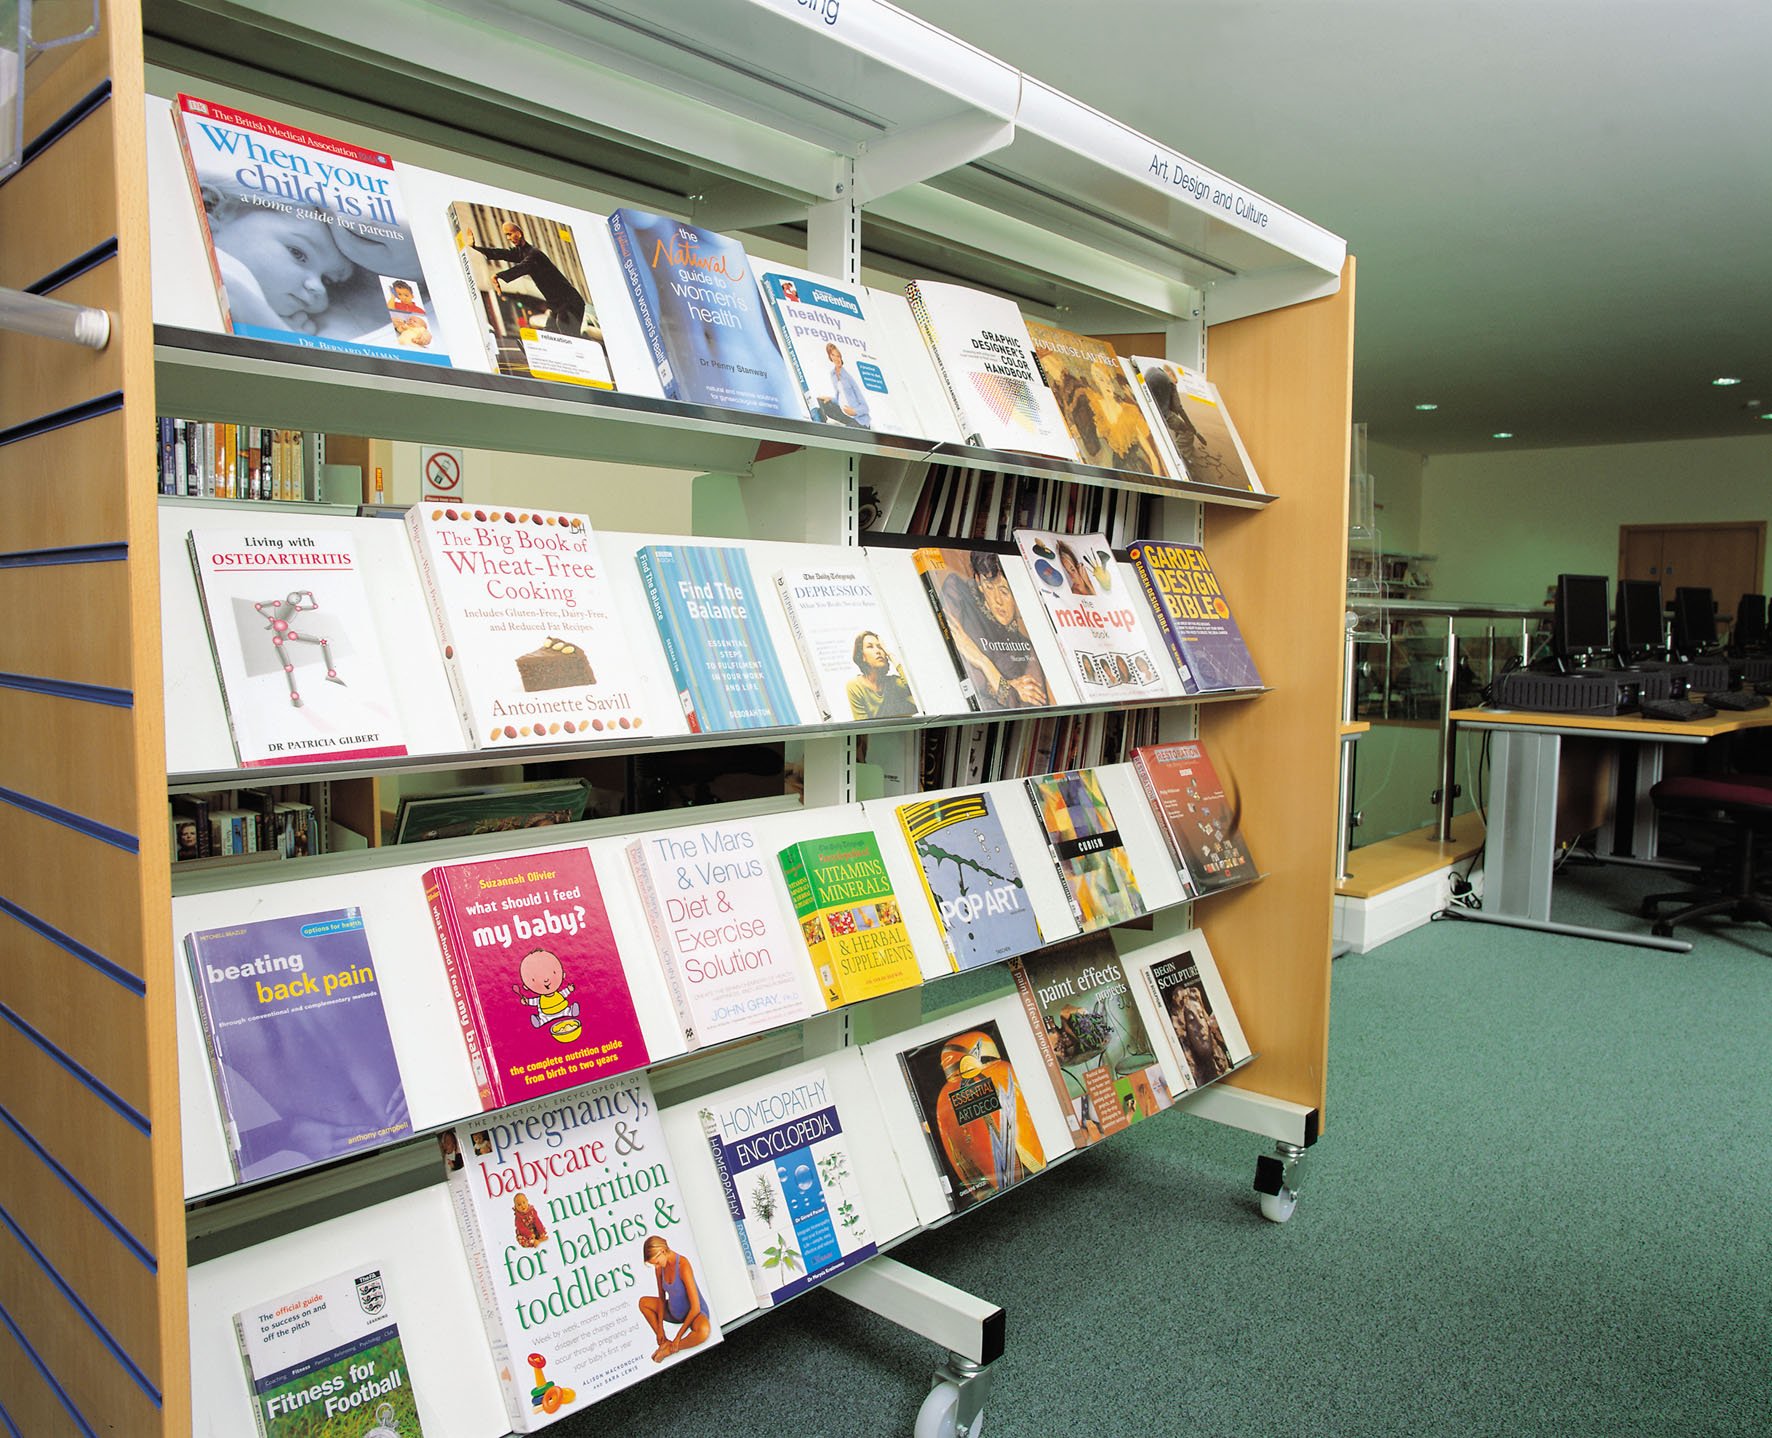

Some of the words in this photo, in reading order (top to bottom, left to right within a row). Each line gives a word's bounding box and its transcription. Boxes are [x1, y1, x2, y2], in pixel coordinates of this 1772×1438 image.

[213, 109, 232, 122] The
[235, 114, 266, 132] British
[268, 124, 305, 143] Medical
[307, 136, 357, 158] Association
[197, 122, 309, 176] When
[317, 161, 389, 196] your
[236, 164, 329, 208] child
[335, 187, 362, 217] is
[368, 197, 399, 226] ill
[1149, 154, 1168, 182] Art,
[1173, 165, 1210, 199] Design
[1213, 190, 1233, 209] and
[1235, 197, 1268, 227] Culture
[240, 194, 249, 203] a
[252, 193, 292, 214] home
[296, 207, 333, 225] guide
[337, 215, 355, 229] for
[358, 221, 404, 241] parents
[678, 228, 698, 242] the
[652, 233, 744, 282] Natural
[461, 253, 478, 301] relaxation
[679, 268, 712, 284] guide
[714, 275, 727, 289] to
[671, 282, 749, 312] women's
[812, 290, 858, 313] parenting
[688, 301, 743, 330] health
[786, 306, 841, 330] healthy
[794, 324, 867, 351] pregnancy
[971, 338, 1025, 359] DESIGNER'S
[981, 330, 1021, 348] GRAPHIC
[700, 358, 709, 367] Dr
[711, 360, 735, 373] Penny
[736, 364, 768, 378] Stanway
[984, 362, 1035, 382] HANDBOOK
[1001, 356, 1029, 370] COLOR
[245, 537, 283, 549] Living
[289, 537, 315, 547] with
[437, 530, 471, 547] The
[474, 527, 515, 555] Big
[516, 530, 570, 551] Book
[573, 539, 588, 553] of
[212, 553, 352, 566] OSTEOARTHRITIS
[443, 551, 597, 579] Wheat-Free
[1144, 545, 1211, 571] GARDEN
[487, 580, 577, 607] Cooking
[678, 580, 714, 600] Find
[714, 582, 744, 600] The
[795, 585, 872, 598] DEPRESSION
[1152, 569, 1221, 595] DESIGN
[686, 601, 748, 620] Balance
[1081, 600, 1094, 609] the
[1135, 561, 1150, 589] GARDEN
[1146, 588, 1161, 615] DESIGN
[1158, 613, 1170, 634] BIBLE
[1163, 593, 1220, 620] BIBLE
[1055, 604, 1136, 632] make-up
[980, 637, 1031, 651] Portraiture
[1091, 629, 1110, 639] book
[492, 698, 582, 717] Antoinette
[587, 692, 631, 710] Savill
[268, 742, 284, 752] DR
[288, 738, 336, 750] PATRICIA
[339, 733, 381, 745] GILBERT
[1157, 748, 1199, 760] RESTORATION
[652, 838, 698, 862] The
[701, 830, 754, 854] Mars
[1078, 838, 1104, 851] CUBISM
[478, 873, 526, 890] Suzannah
[527, 870, 556, 882] Olivier
[677, 866, 694, 889] &
[696, 859, 764, 886] Venus
[465, 900, 498, 917] what
[501, 891, 542, 910] should
[545, 891, 550, 903] i
[552, 886, 581, 901] feed
[819, 876, 890, 903] MINERALS
[666, 895, 712, 923] Diet
[717, 890, 734, 913] &
[939, 893, 984, 927] POP
[985, 885, 1020, 916] ART
[304, 925, 329, 935] options
[330, 923, 340, 931] for
[342, 919, 363, 929] health
[472, 923, 512, 949] my
[513, 905, 587, 939] baby?
[674, 919, 766, 953] Exercise
[839, 940, 850, 955] &
[852, 928, 905, 953] HERBAL
[207, 953, 305, 984] beating
[684, 948, 772, 984] Solution
[841, 944, 913, 975] SUPPLEMENTS
[1153, 962, 1176, 978] BEGIN
[255, 972, 320, 1004] back
[322, 964, 375, 996] pain
[1038, 976, 1076, 1009] paint
[1077, 963, 1122, 992] effects
[1158, 965, 1200, 989] SCULPTURE
[1095, 982, 1128, 1004] projects
[218, 1017, 247, 1029] through
[247, 1007, 290, 1022] conventional
[290, 1005, 303, 1013] and
[304, 996, 351, 1010] complementary
[352, 990, 378, 1001] methods
[711, 1005, 745, 1022] JOHN
[509, 1065, 525, 1077] the
[527, 1056, 564, 1072] complete
[564, 1046, 600, 1064] nutrition
[601, 1040, 623, 1054] guide
[524, 1073, 545, 1085] from
[547, 1067, 567, 1079] birth
[569, 1064, 578, 1073] to
[580, 1059, 595, 1070] two
[596, 1054, 618, 1068] years
[467, 1119, 487, 1129] THE
[493, 1102, 550, 1122] PRACTICAL
[554, 1081, 625, 1106] ENCYCLOPEDIA
[951, 1081, 994, 1107] ESSENTIAL
[720, 1079, 828, 1138] HOMEOPATHY
[958, 1106, 973, 1123] ART
[973, 1096, 999, 1118] DECO
[347, 1130, 377, 1145] anthony
[377, 1121, 409, 1137] campbell
[489, 1086, 649, 1165] pregnancy,
[736, 1114, 834, 1166] ENCYCLOPEDIA
[479, 1140, 607, 1199] babycare
[614, 1121, 644, 1156] &
[709, 1139, 740, 1216] HOMEOPATHY
[547, 1161, 670, 1223] nutrition
[503, 1245, 547, 1287] for
[553, 1210, 648, 1267] babies
[653, 1197, 681, 1229] &
[258, 1312, 274, 1323] The
[275, 1302, 301, 1317] official
[302, 1294, 323, 1307] guide
[515, 1262, 636, 1330] toddlers
[261, 1324, 270, 1333] to
[271, 1313, 300, 1328] success
[301, 1310, 311, 1318] on
[312, 1302, 327, 1313] and
[263, 1333, 275, 1343] off
[276, 1329, 289, 1338] the
[290, 1320, 311, 1334] pitch
[366, 1314, 388, 1326] LEARNING
[582, 1374, 604, 1386] ALISON
[605, 1354, 644, 1375] MACKONOCHIE
[266, 1374, 345, 1419] Fitness
[349, 1360, 375, 1384] for
[324, 1369, 402, 1419] Football
